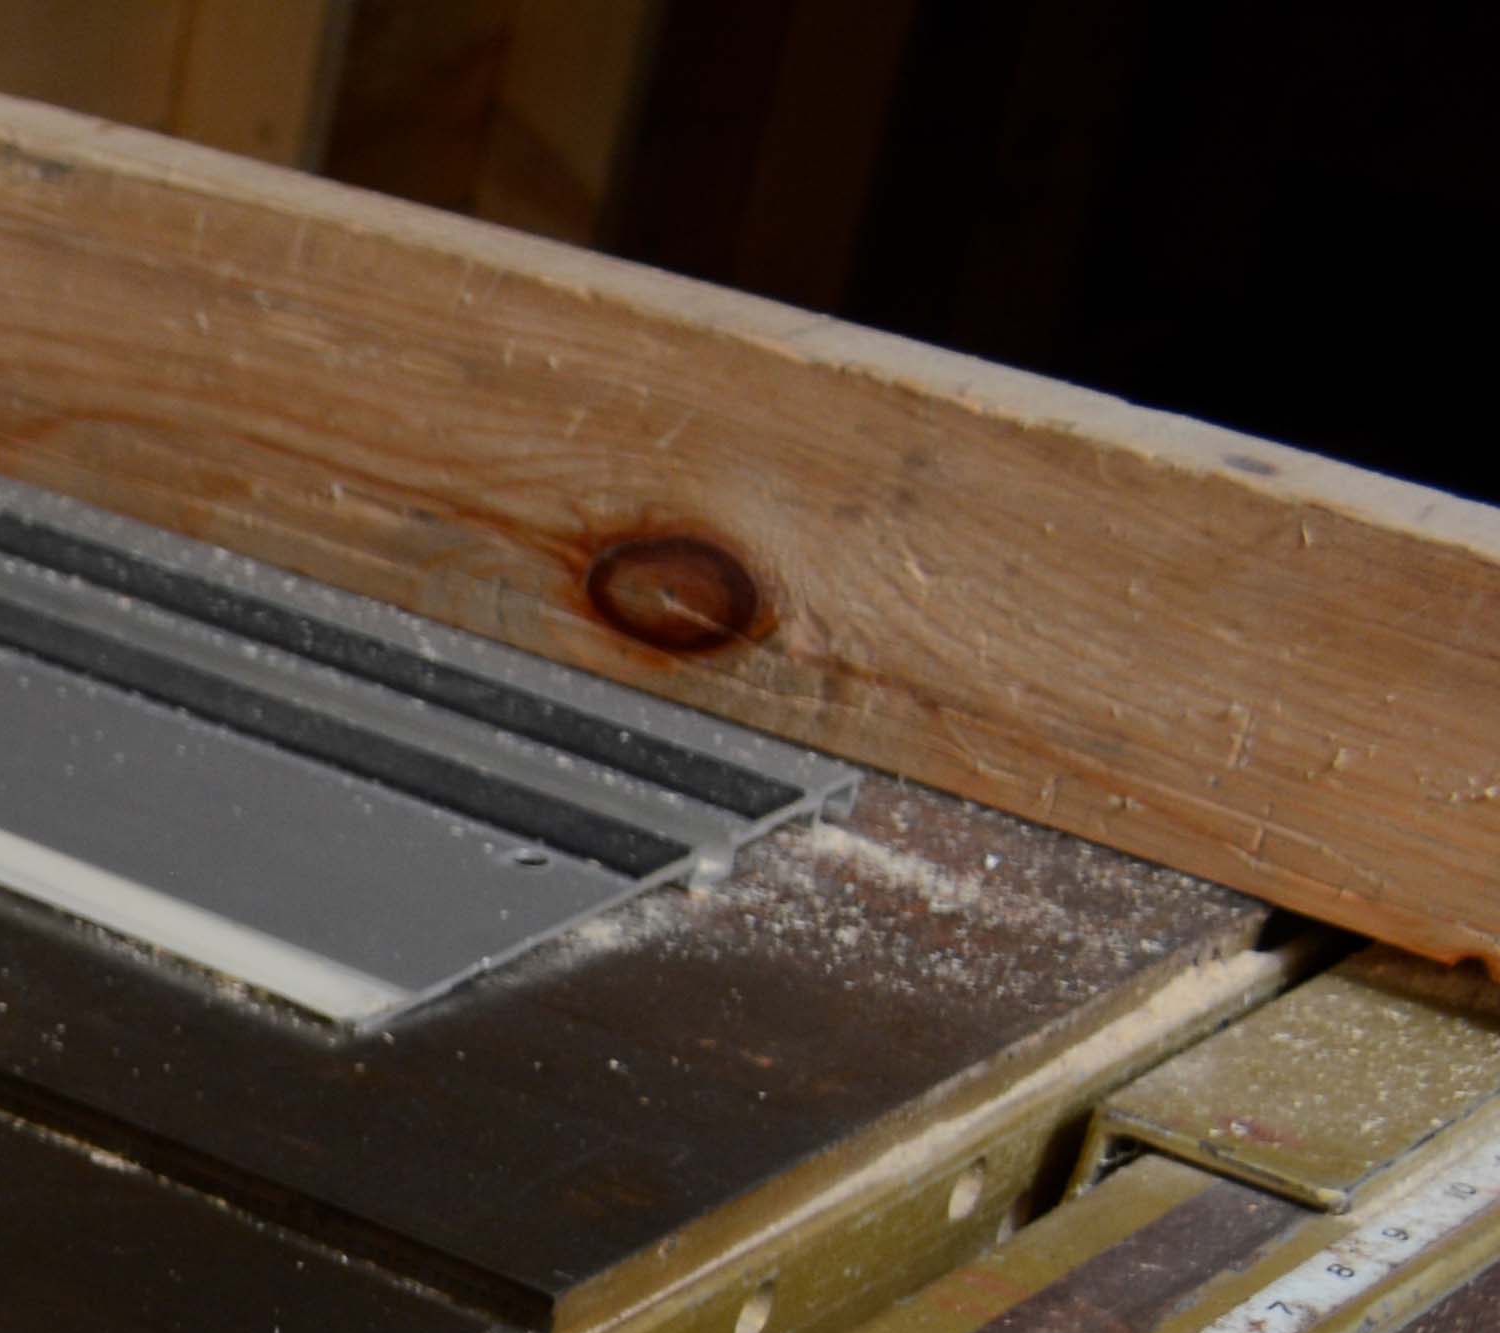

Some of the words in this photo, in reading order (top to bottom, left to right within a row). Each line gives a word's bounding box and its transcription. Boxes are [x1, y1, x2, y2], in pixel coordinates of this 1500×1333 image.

[1268, 1301, 1293, 1315] 7
[1327, 1263, 1355, 1278] 8
[1382, 1227, 1409, 1241] 9
[1444, 1182, 1477, 1200] 10
